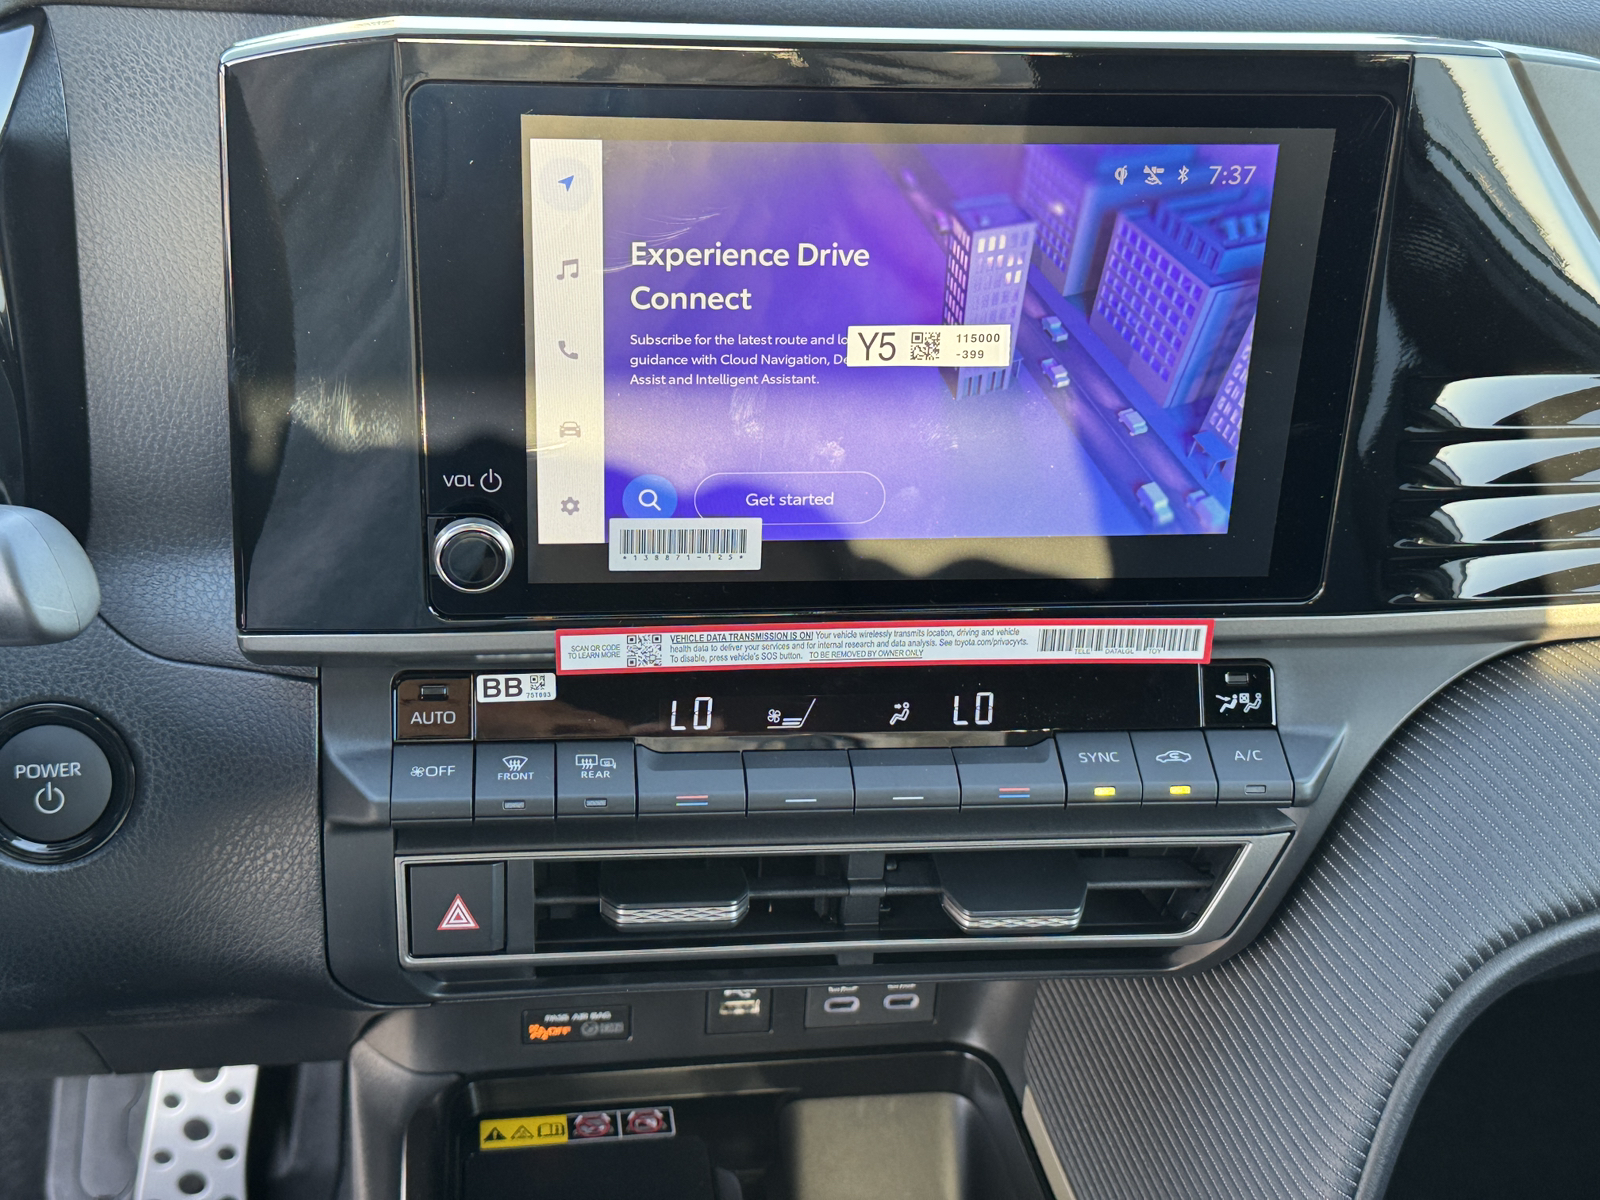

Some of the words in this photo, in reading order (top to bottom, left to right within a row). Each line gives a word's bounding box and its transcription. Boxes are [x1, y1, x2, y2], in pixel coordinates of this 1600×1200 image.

[1209, 165, 1257, 185] 7:37
[631, 241, 789, 272] Experience
[798, 242, 870, 267] Drive
[630, 286, 752, 310] Connect
[630, 334, 692, 346] Subscribe
[694, 334, 712, 346] for
[714, 334, 735, 346] the
[738, 334, 773, 346] latest
[775, 334, 808, 346] route
[810, 334, 835, 346] and
[956, 333, 1000, 343] 115000
[858, 332, 897, 361] Y5
[630, 354, 689, 368] guidance
[691, 354, 717, 365] with
[720, 354, 758, 365] Cloud
[761, 353, 830, 368] Navigation,
[956, 350, 985, 359] -399
[630, 374, 666, 385] Assist
[668, 374, 693, 385] and
[696, 374, 759, 388] Intelligent
[761, 374, 820, 385] Assistant.
[443, 475, 475, 487] VOL
[745, 493, 775, 506] Get
[779, 492, 834, 506] started
[670, 634, 705, 643] VEHICLE
[706, 633, 727, 642] DATA
[728, 632, 789, 641] TRANSMISSION
[790, 631, 798, 640] IS
[816, 631, 831, 640] Your
[832, 631, 857, 639] vehicle
[859, 630, 893, 640] wirelessly
[894, 629, 925, 638] transmits
[926, 628, 955, 638] location,
[956, 628, 979, 638] driving
[981, 627, 995, 636] and
[996, 627, 1020, 636] vehicle
[571, 645, 589, 653] SCAN
[601, 644, 621, 652] CODE
[670, 645, 692, 653] health
[693, 644, 709, 653] data
[711, 644, 718, 652] to
[719, 643, 743, 652] deliver
[744, 644, 760, 654] your
[761, 642, 790, 651] services
[791, 641, 805, 650] and
[806, 641, 816, 649] for
[817, 640, 843, 649] internal
[844, 640, 875, 649] research
[876, 640, 890, 648] and
[891, 639, 906, 648] data
[907, 638, 937, 649] analysis.
[939, 638, 953, 647] See
[670, 655, 679, 663] To
[680, 654, 707, 663] disable,
[709, 654, 729, 663] press
[729, 653, 760, 662] vehicle's
[761, 652, 778, 660] SOS
[779, 651, 803, 660] button.
[809, 651, 819, 659] TO
[820, 651, 830, 659] BE
[831, 650, 866, 658] REMOVED
[867, 650, 877, 658] BY
[878, 649, 904, 657] OWNER
[905, 649, 924, 657] ONLY
[483, 677, 523, 698] BB
[410, 710, 457, 725] AUTO
[1078, 752, 1120, 763] SYNC
[1234, 750, 1263, 762] A/C
[15, 762, 82, 779] POWER
[425, 765, 456, 777] OFF
[497, 771, 534, 781] FRONT
[581, 770, 611, 779] REAR
